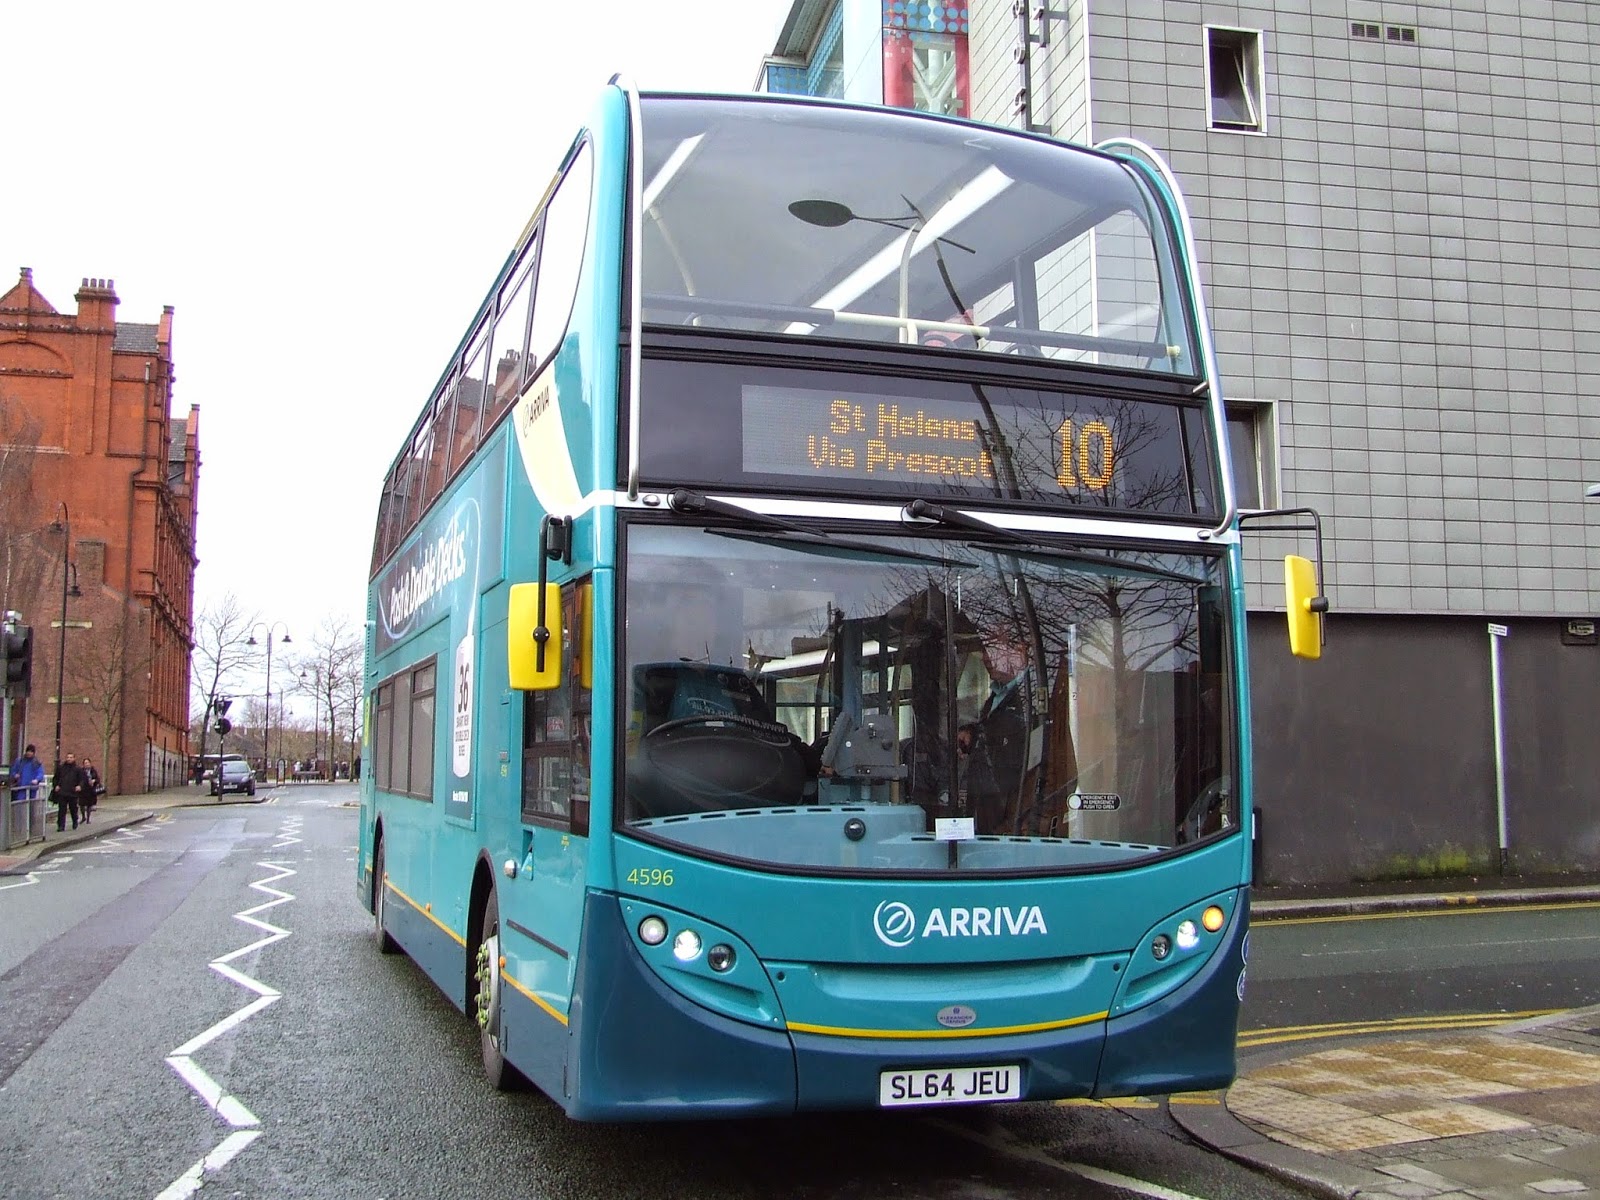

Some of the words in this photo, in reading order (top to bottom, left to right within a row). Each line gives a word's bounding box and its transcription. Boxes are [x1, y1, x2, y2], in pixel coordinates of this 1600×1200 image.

[830, 399, 866, 434] St
[877, 402, 975, 441] Helens
[807, 434, 856, 469] Via
[866, 438, 993, 479] Prescot
[1056, 419, 1113, 490] 10
[458, 662, 470, 714] 36
[627, 868, 674, 886] 4596
[921, 905, 1048, 938] ARRIVA
[891, 1072, 955, 1099] SL64
[963, 1070, 1010, 1096] JEU
